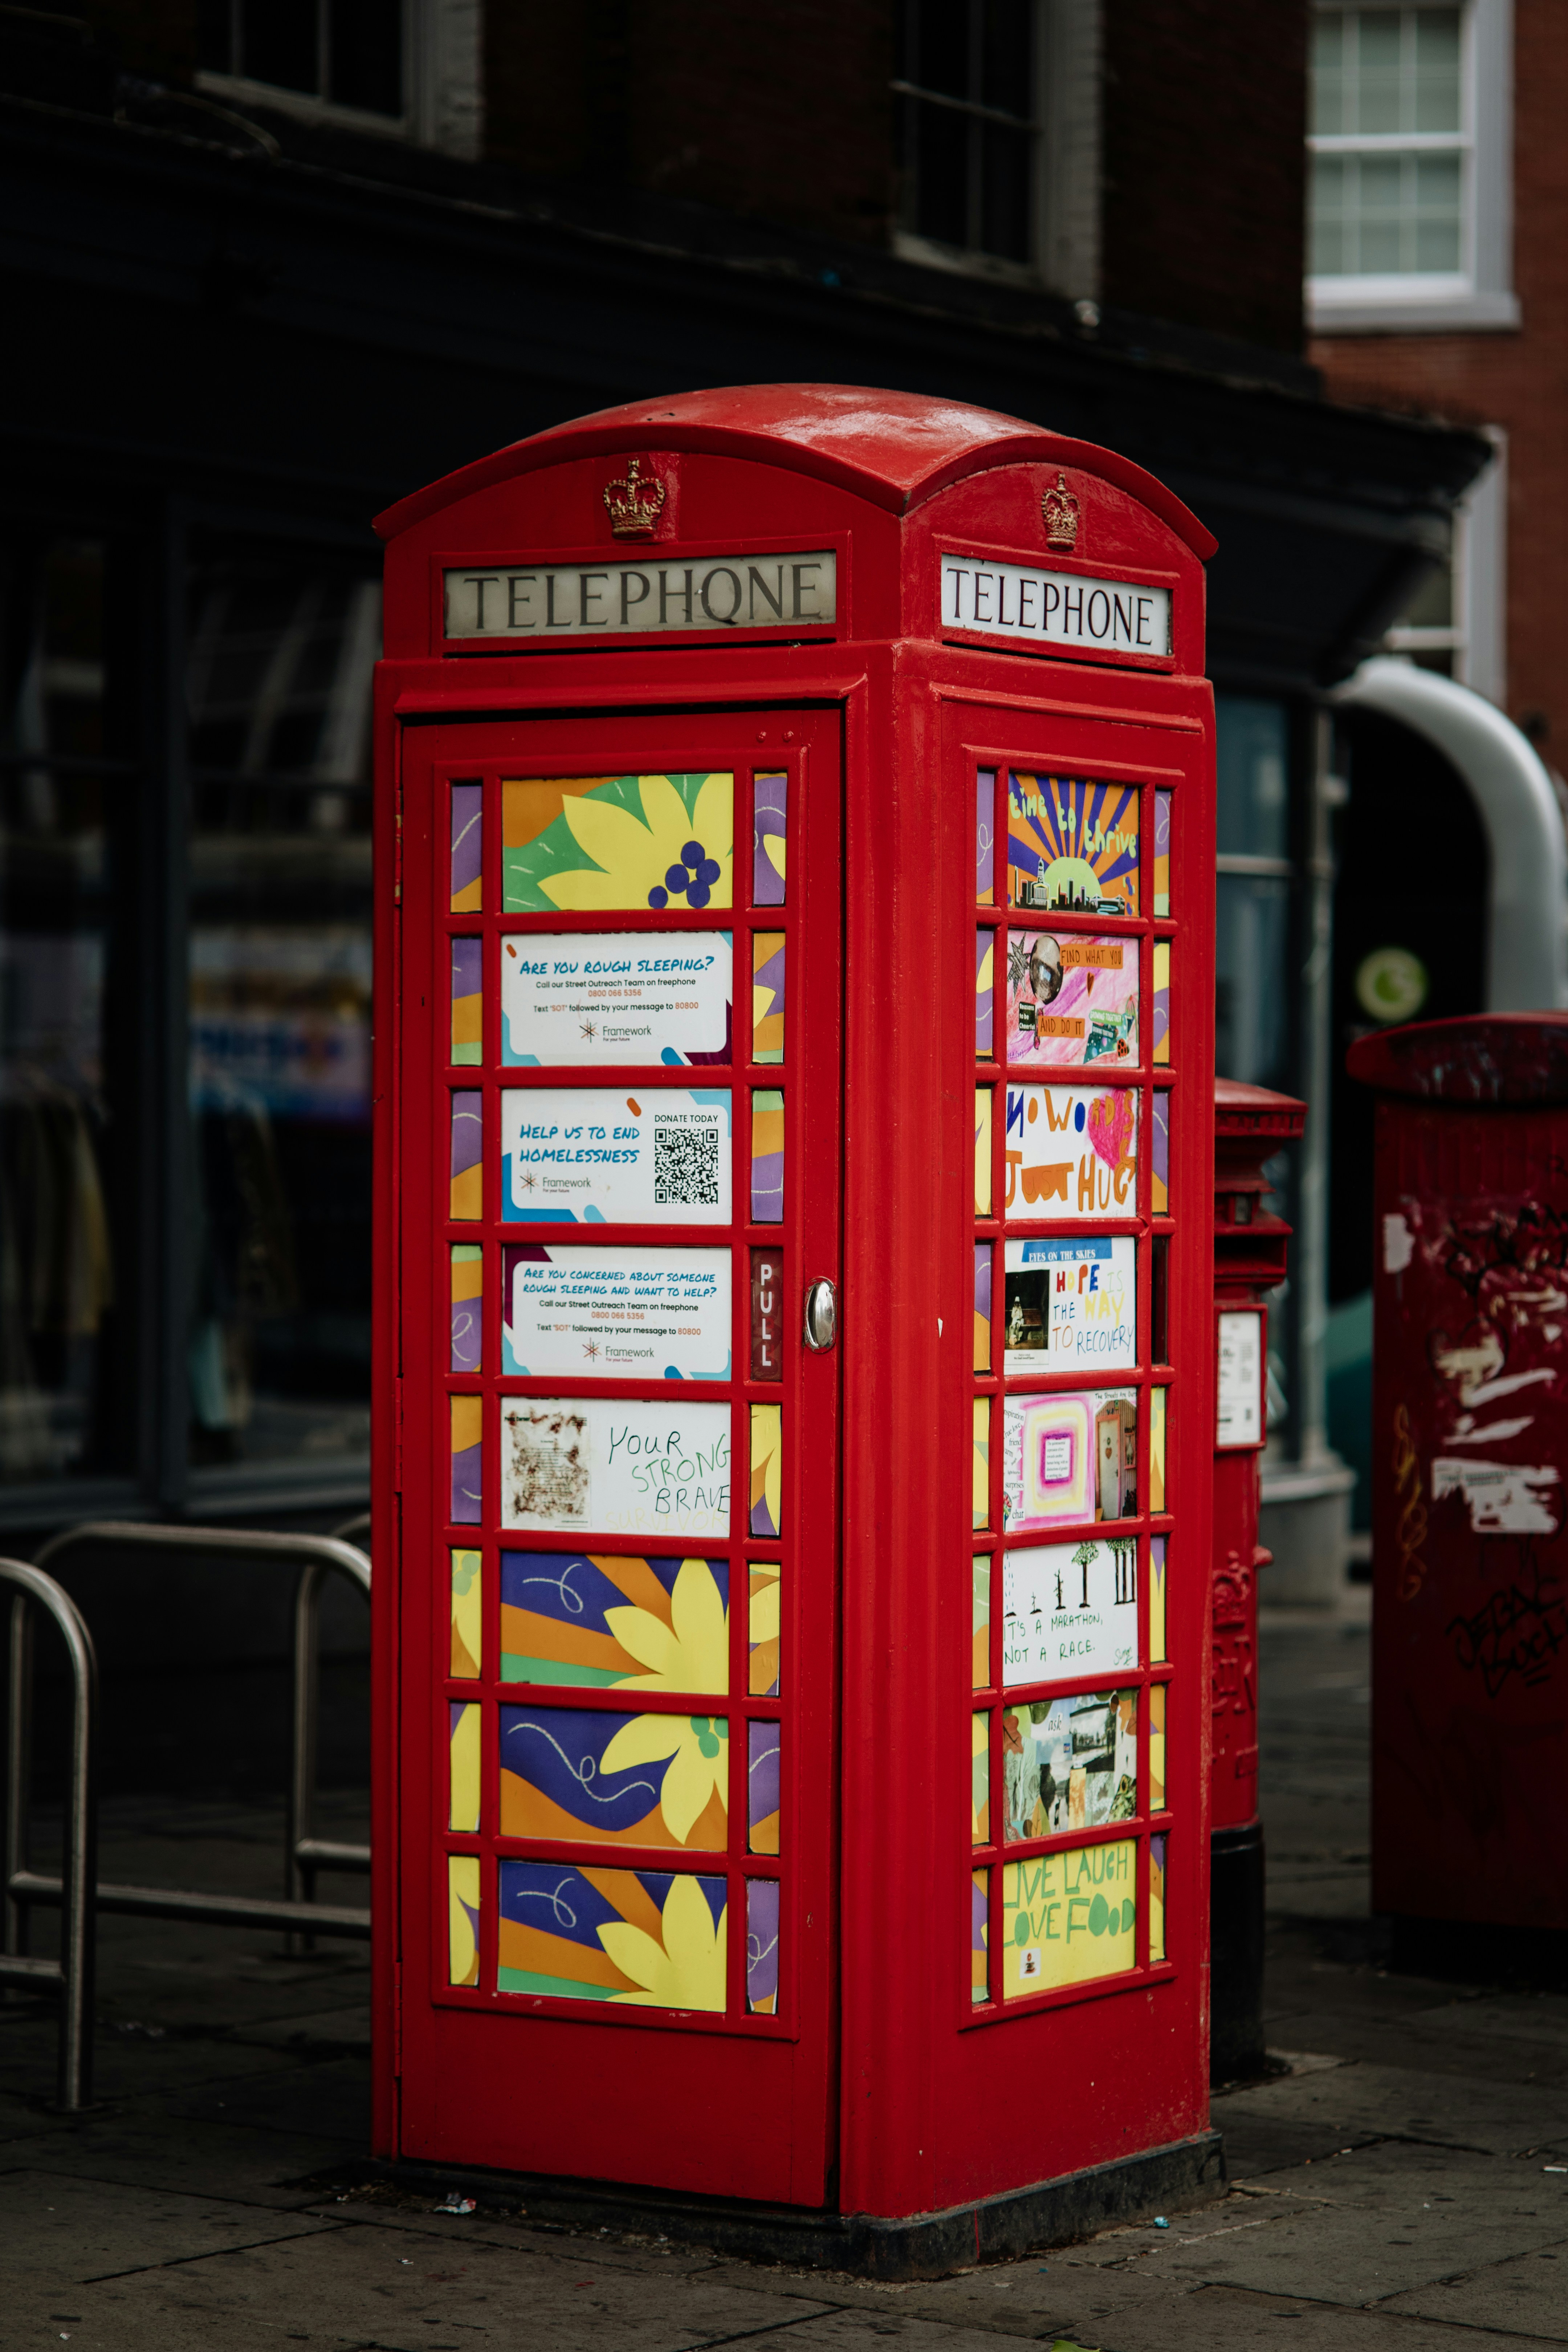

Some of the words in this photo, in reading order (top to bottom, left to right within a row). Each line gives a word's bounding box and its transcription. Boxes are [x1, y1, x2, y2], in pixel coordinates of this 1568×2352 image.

[464, 563, 822, 629] TELEPHONE
[946, 567, 1154, 646] TELEPHONE
[1057, 801, 1076, 833] to
[1084, 819, 1136, 859] thrive
[520, 960, 547, 974] ARE
[554, 961, 578, 974] YOU
[584, 960, 631, 973] ROUGH
[638, 956, 714, 972] SLEEPING?
[1061, 949, 1080, 964] FIND
[1086, 949, 1105, 964] WHAT
[1110, 950, 1121, 965] YOU
[658, 978, 696, 987] freephone
[602, 1004, 610, 1013] by
[612, 1005, 628, 1013] your
[603, 1025, 652, 1036] Framework
[1040, 1018, 1056, 1033] AND
[1062, 1019, 1070, 1034] DO
[1075, 1021, 1082, 1035] IT
[1007, 1089, 1038, 1138] NO
[1044, 1088, 1134, 1133] WORDS
[520, 1124, 558, 1139] HELP
[565, 1127, 583, 1139] US
[588, 1126, 606, 1139] TO
[613, 1127, 640, 1139] END
[520, 1148, 640, 1163] HOMELESSNESS
[543, 1177, 591, 1187] Framework
[1006, 1150, 1074, 1208] JUST
[1029, 1252, 1046, 1262] EYES
[1048, 1252, 1058, 1261] ON
[1060, 1250, 1074, 1261] THE
[1076, 1249, 1096, 1259] SKIES
[524, 1268, 544, 1278] ARE
[549, 1270, 566, 1278] YOU
[570, 1270, 625, 1280] CONCERNED
[630, 1272, 664, 1282] ABOUT
[667, 1273, 715, 1282] SOMEONE
[1057, 1264, 1100, 1294] HOPE
[1107, 1270, 1123, 1293] IS
[523, 1284, 556, 1293] ROUGH
[561, 1285, 607, 1294] SLEEPING
[611, 1286, 630, 1295] AND
[635, 1287, 664, 1296] WANT
[667, 1288, 679, 1296] TO
[684, 1287, 717, 1297] HELP?
[661, 1303, 698, 1312] freephone
[760, 1264, 772, 1366] PULL
[1054, 1302, 1075, 1321] THE
[1085, 1289, 1125, 1328] WAY
[604, 1326, 614, 1334] by
[634, 1328, 667, 1336] message
[1052, 1326, 1073, 1351] TO
[1077, 1325, 1135, 1356] RECOVERY
[606, 1346, 654, 1357] Framework
[1004, 1409, 1024, 1421] nspiration
[609, 1426, 683, 1464] YOUR
[632, 1433, 730, 1492] STRONG
[1005, 1481, 1024, 1490] surprises
[655, 1485, 730, 1514] BRAVE
[605, 1507, 730, 1532] SURVIVOR
[1013, 1509, 1024, 1519] chat
[1004, 1620, 1026, 1641] IT'S
[1036, 1619, 1042, 1635] A
[1051, 1613, 1103, 1632] MARATHON,
[1005, 1645, 1029, 1664] NOT
[1040, 1647, 1046, 1662] A
[1060, 1639, 1095, 1661] RACE.
[1048, 1714, 1062, 1732] ask
[1064, 1846, 1127, 1895] LAUGH
[1066, 1893, 1135, 1944] FOOD
